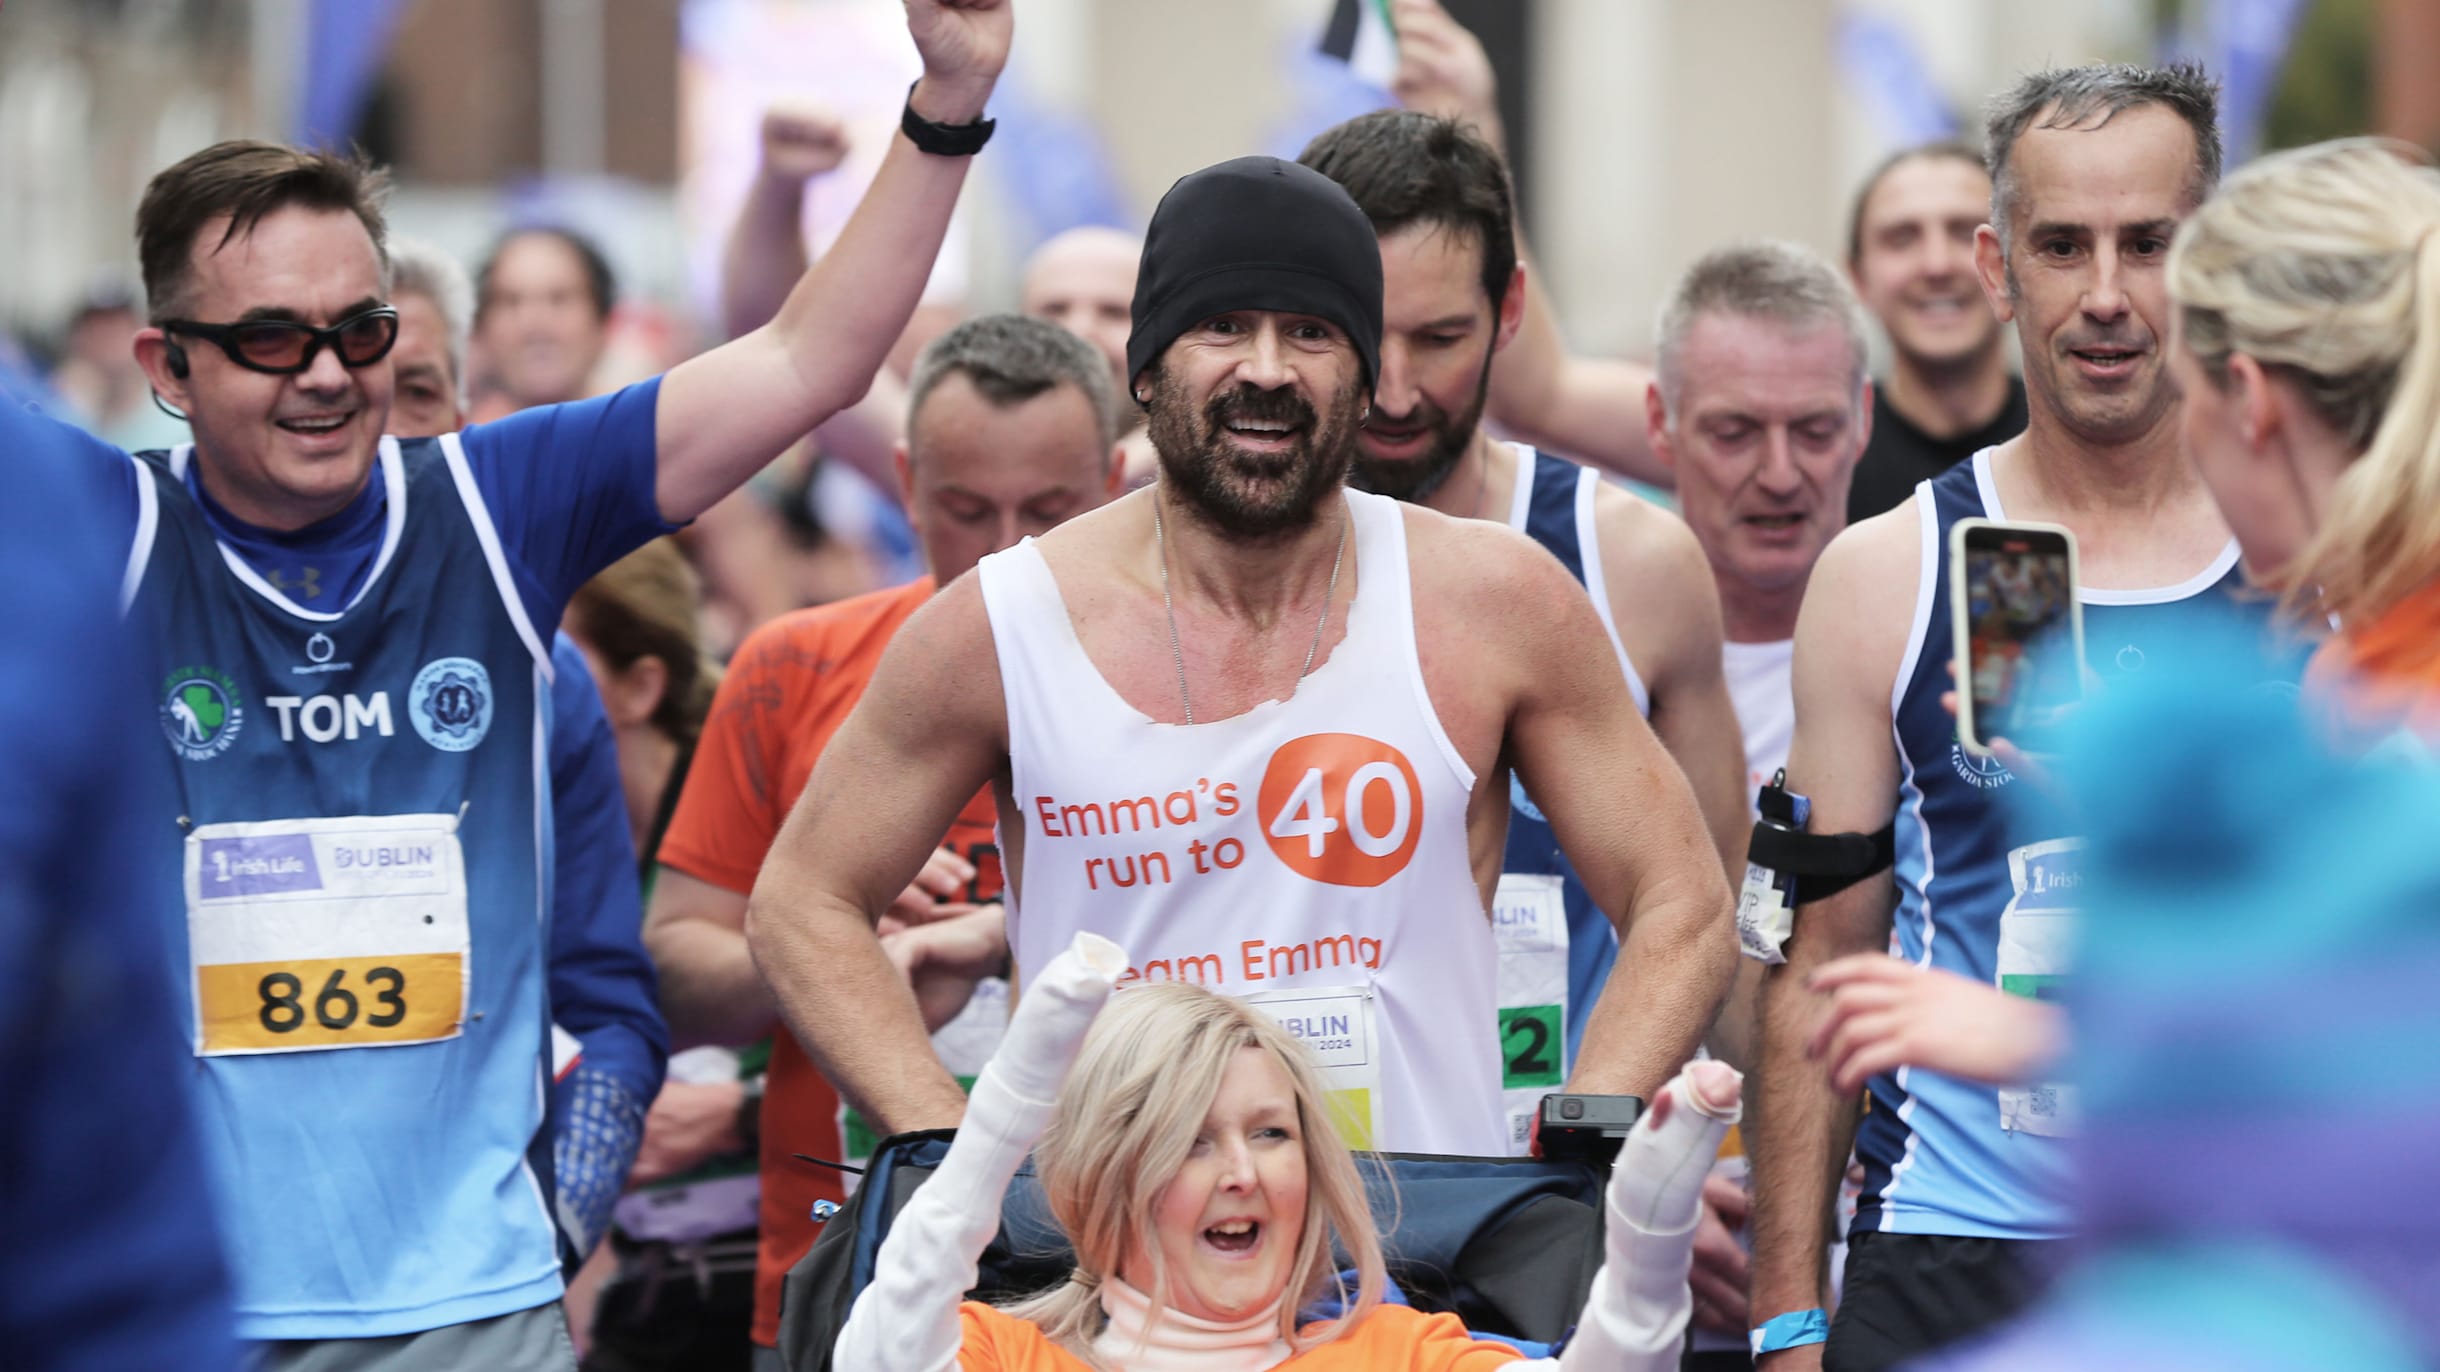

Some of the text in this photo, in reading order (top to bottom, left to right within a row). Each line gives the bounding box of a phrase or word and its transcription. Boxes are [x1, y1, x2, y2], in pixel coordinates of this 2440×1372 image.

[265, 691, 394, 743] TOM
[1952, 754, 1982, 788] GARDA
[1036, 778, 1239, 838] Emma's
[1270, 761, 1411, 858] 40
[232, 856, 304, 876] Irish Life
[335, 846, 433, 868] DUBLIN
[1086, 837, 1245, 890] run to
[1493, 906, 1536, 925] LIN
[1116, 934, 1382, 991] eam Emma
[258, 966, 407, 1033] 863
[1279, 1015, 1349, 1038] BLIN
[1319, 1039, 1352, 1050] 2024
[1502, 1016, 1549, 1074] 2
